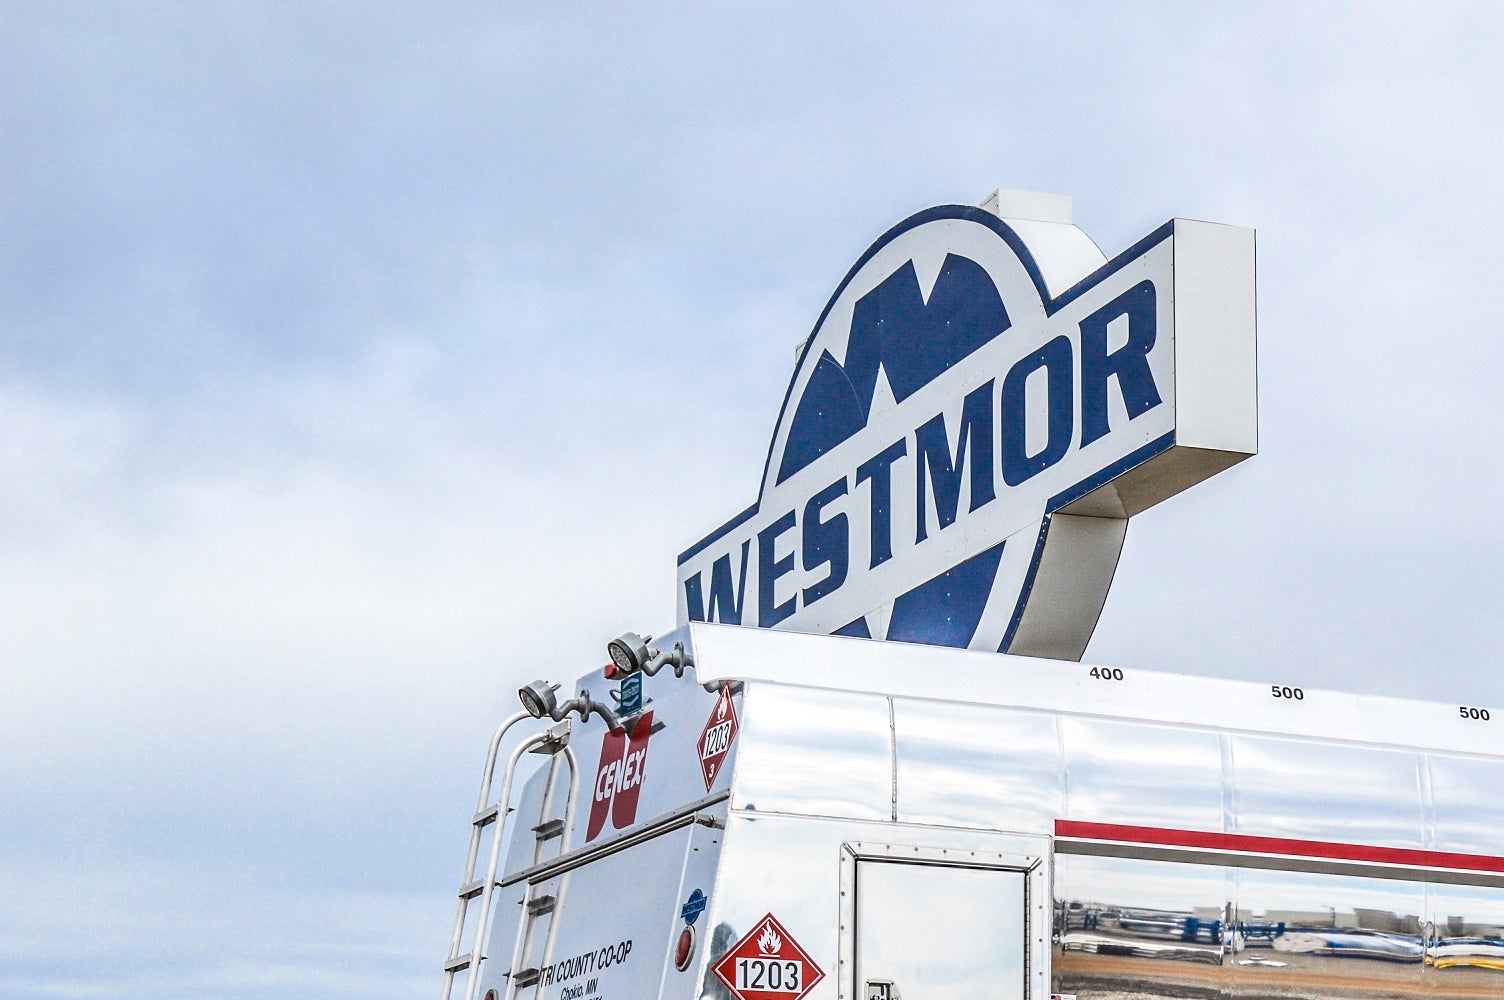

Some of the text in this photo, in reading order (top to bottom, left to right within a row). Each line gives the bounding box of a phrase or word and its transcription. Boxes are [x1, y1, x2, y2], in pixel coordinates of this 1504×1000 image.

[685, 279, 1163, 629] WESTMOR
[1089, 666, 1124, 681] 400
[1271, 685, 1304, 700] 500
[1458, 706, 1490, 721] 500
[705, 722, 730, 757] 1203
[595, 747, 646, 802] CENEX
[708, 763, 715, 778] 3
[539, 939, 633, 988] TRI COUNTY CO-OP
[739, 959, 799, 991] 1203
[585, 977, 599, 996] MN
